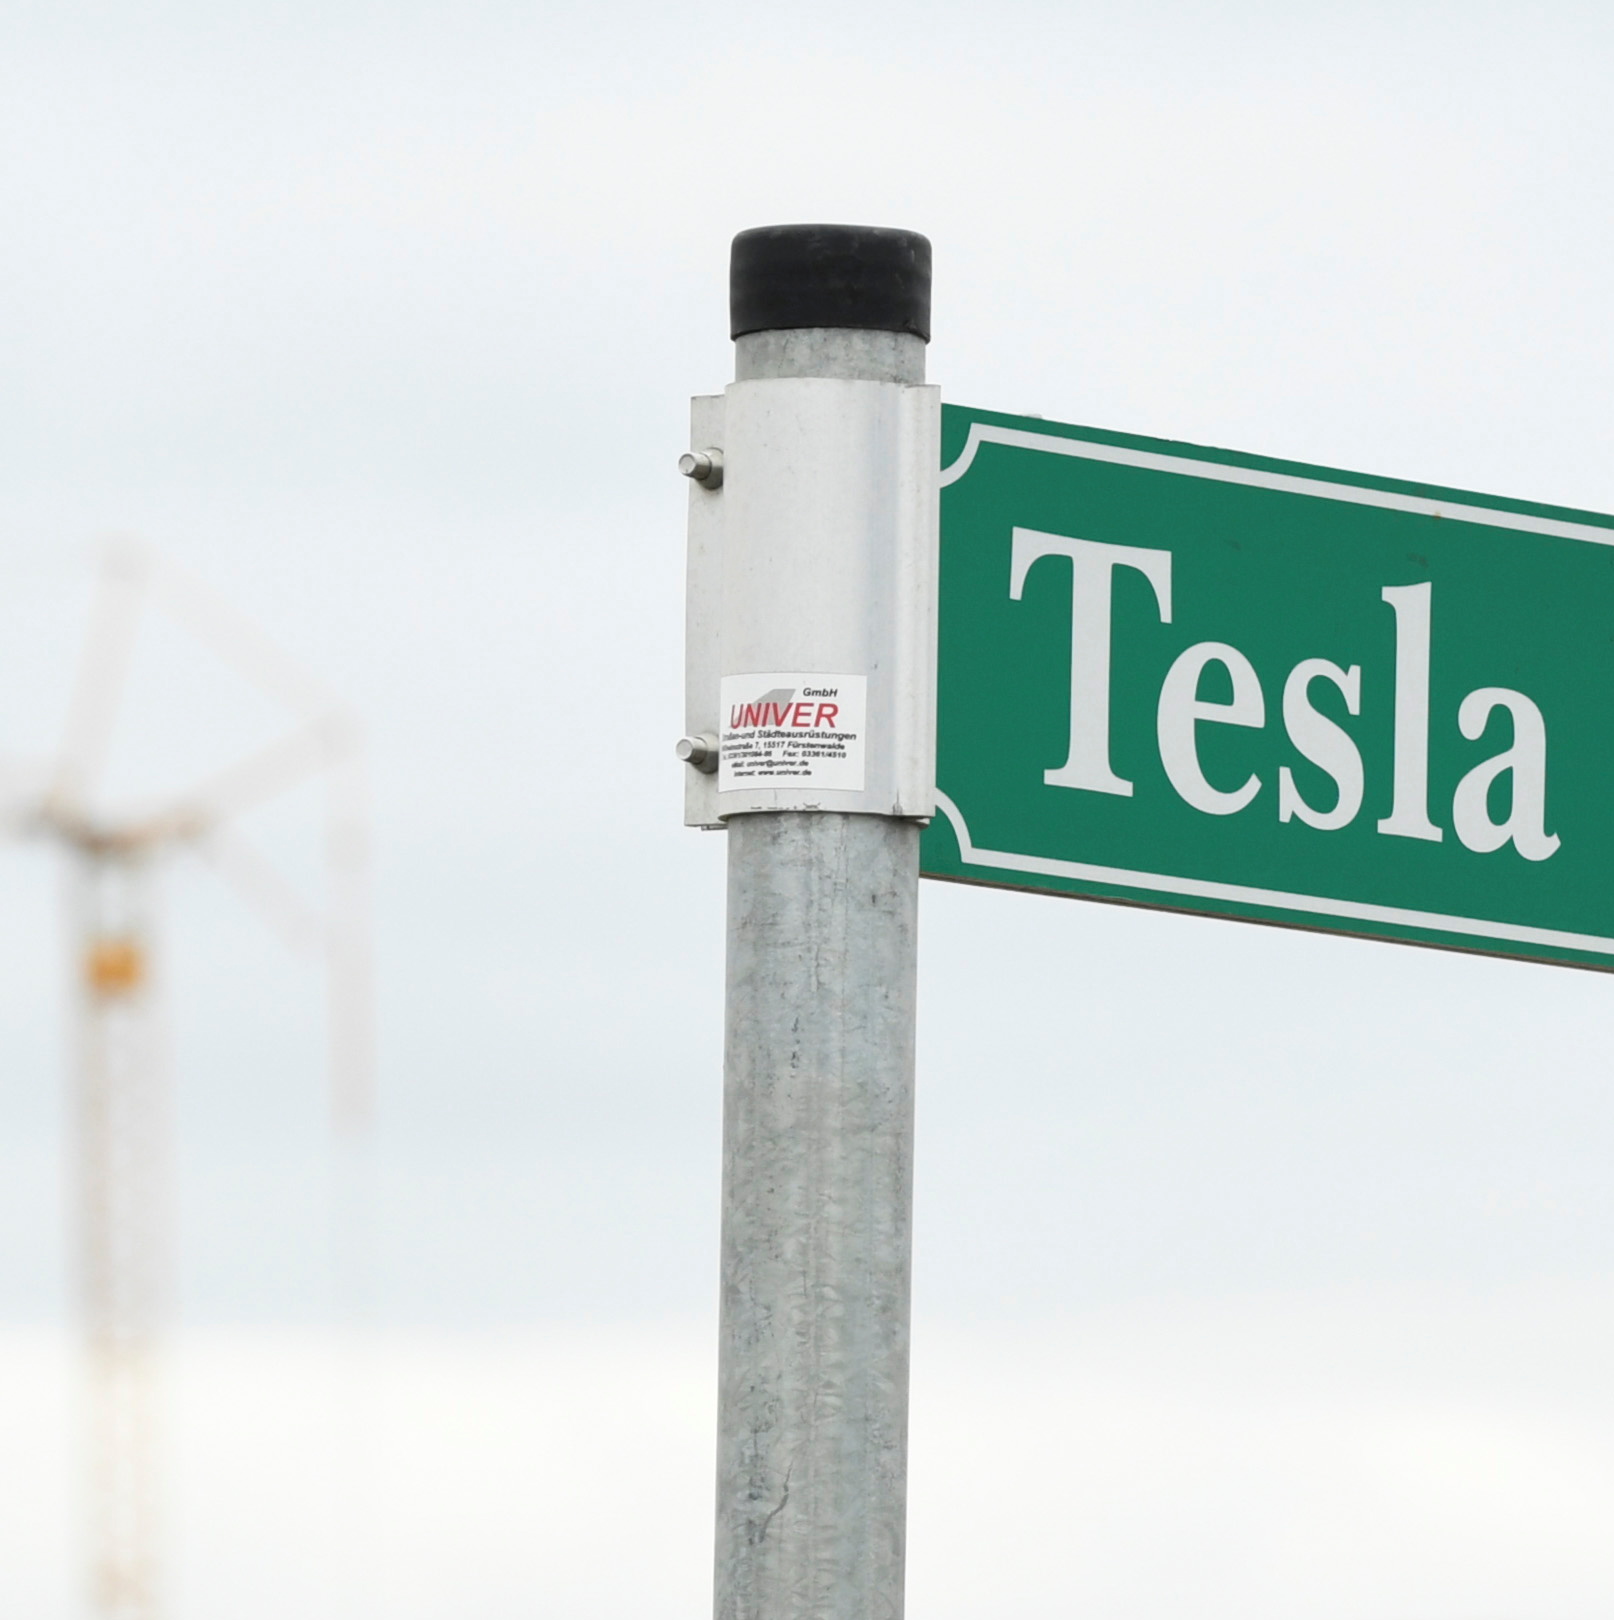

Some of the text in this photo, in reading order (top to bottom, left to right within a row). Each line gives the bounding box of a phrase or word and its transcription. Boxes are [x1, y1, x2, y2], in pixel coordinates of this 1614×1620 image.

[803, 687, 838, 698] GmbH
[1009, 526, 1561, 861] Tesla
[730, 702, 839, 729] UNIVER
[757, 729, 857, 741] Städteausrüstungen
[763, 741, 786, 749] 15517
